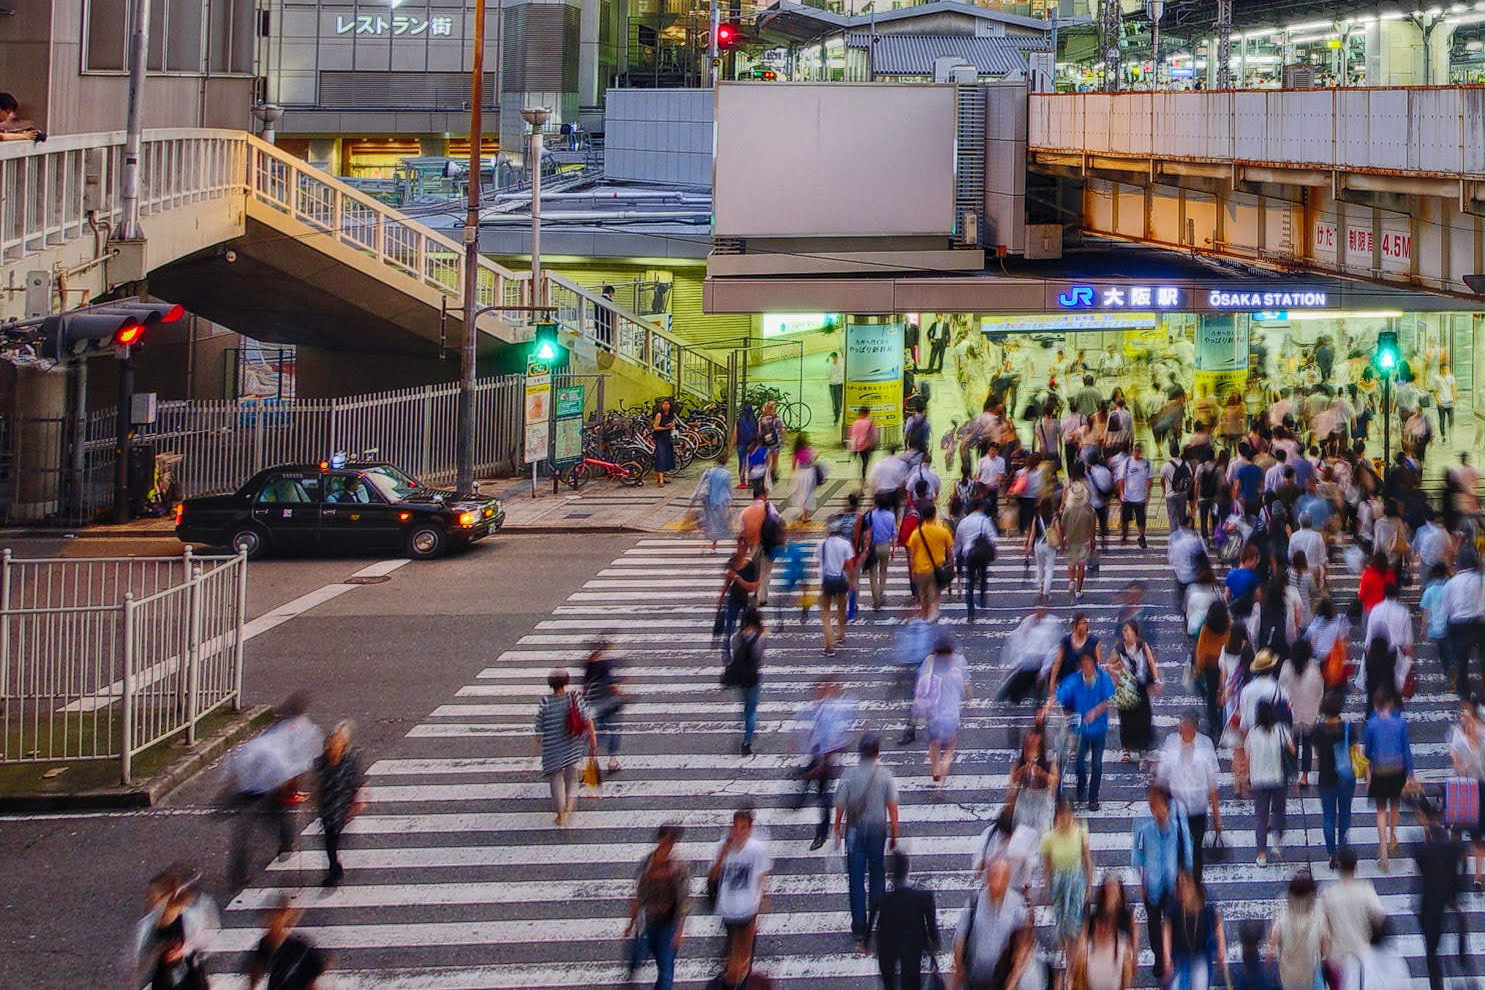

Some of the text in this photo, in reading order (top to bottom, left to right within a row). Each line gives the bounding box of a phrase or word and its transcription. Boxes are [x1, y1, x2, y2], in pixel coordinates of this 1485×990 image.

[336, 16, 453, 37] レストラン街
[1058, 285, 1179, 307] JR 大阪駅
[1263, 292, 1327, 307] STATION
